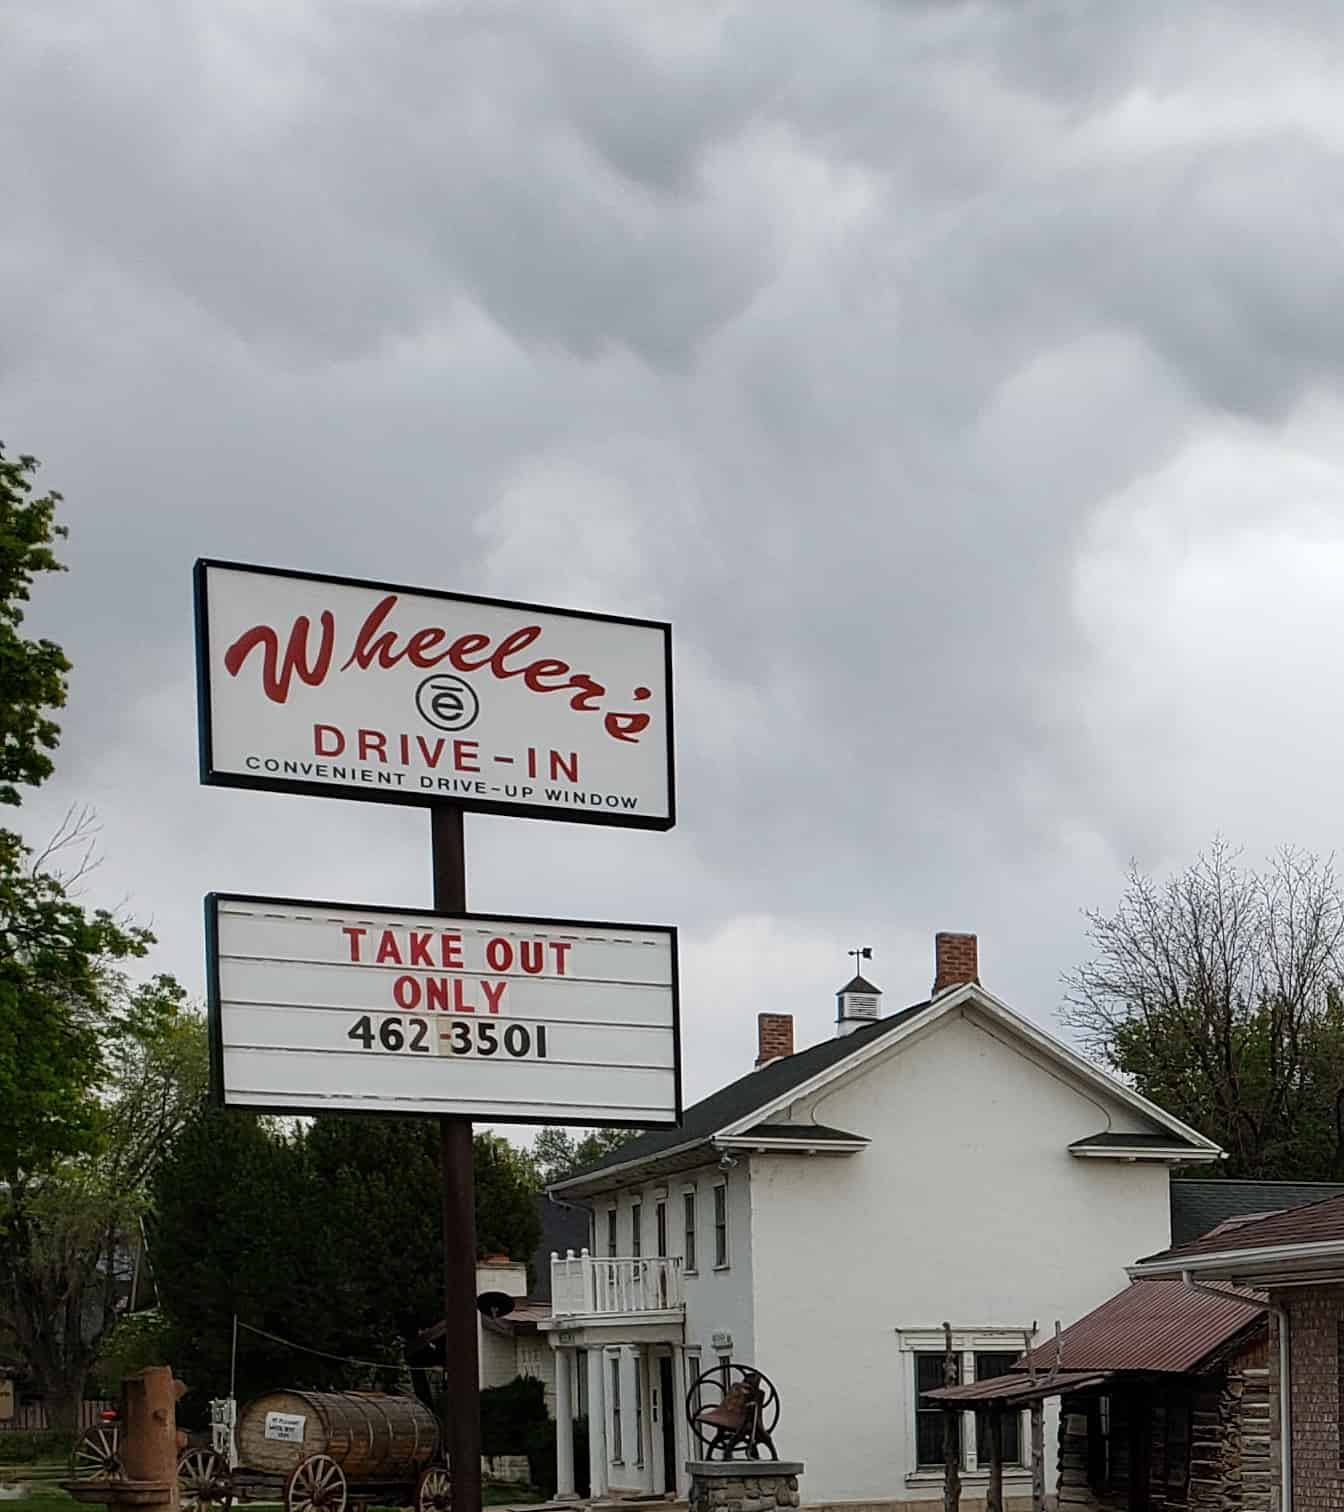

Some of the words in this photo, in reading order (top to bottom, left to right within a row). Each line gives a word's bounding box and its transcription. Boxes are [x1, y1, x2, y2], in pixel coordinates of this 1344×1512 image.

[224, 594, 652, 743] Wheeler's
[313, 723, 579, 784] DRIVE-IN
[245, 755, 406, 786] CONVENIENT
[419, 775, 534, 800] DRIVE-UP
[544, 787, 639, 810] WINDOW
[342, 927, 464, 969] TAKE
[485, 937, 572, 976] OUT
[393, 975, 507, 1014] ONLY
[348, 1015, 547, 1059] 462-3501
